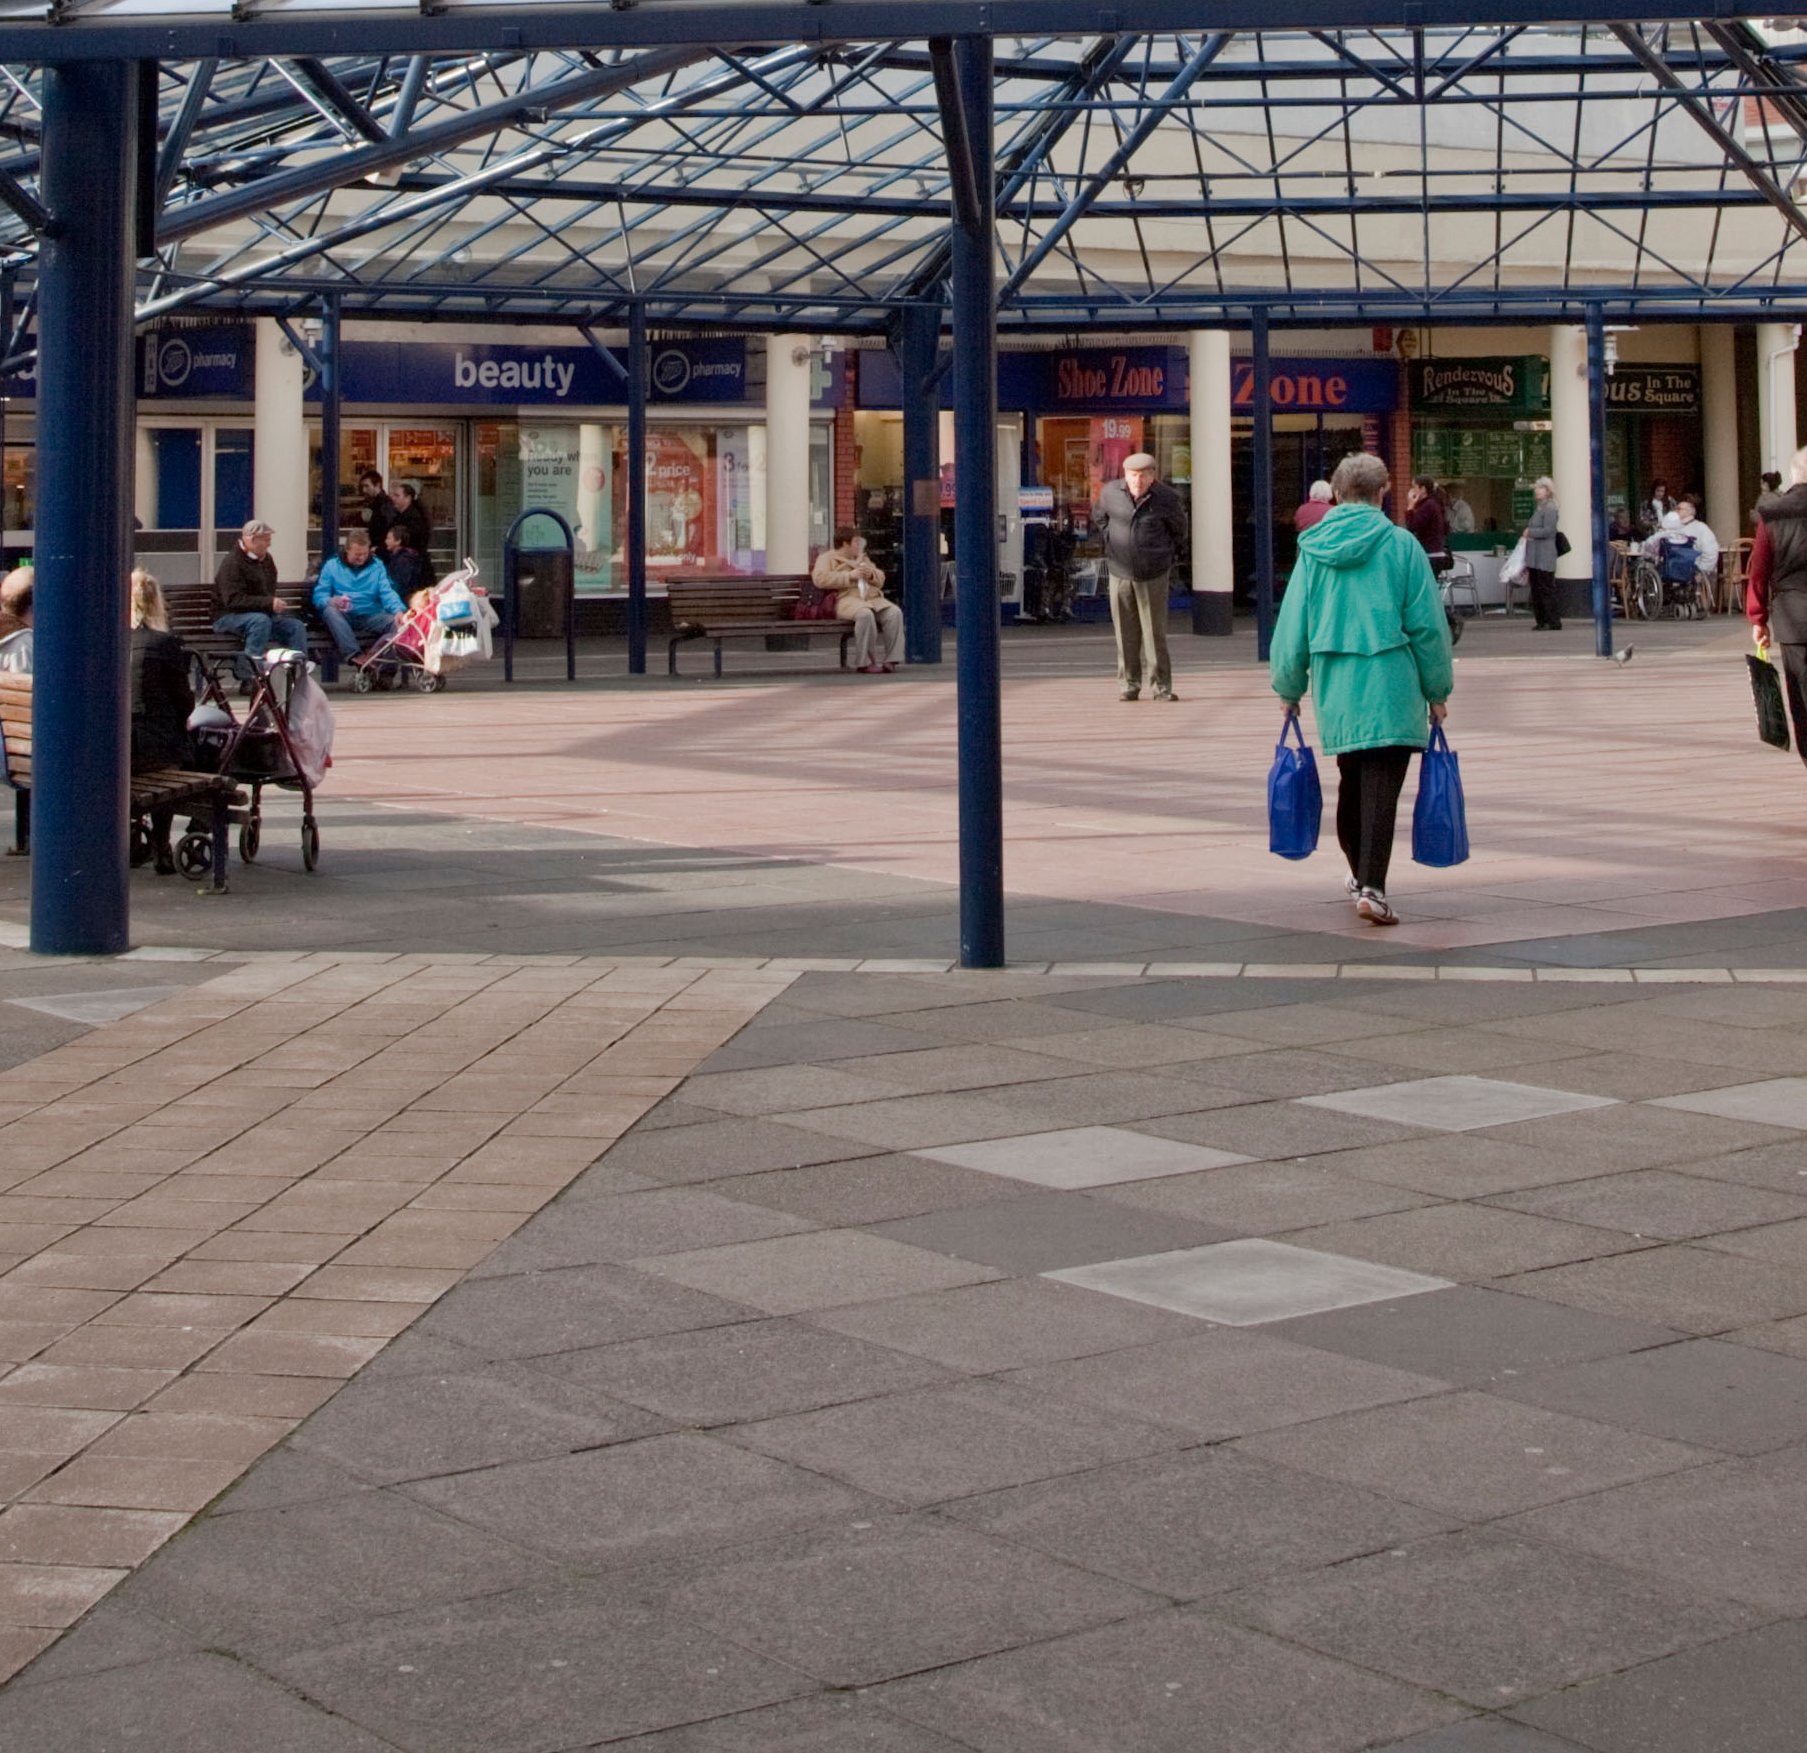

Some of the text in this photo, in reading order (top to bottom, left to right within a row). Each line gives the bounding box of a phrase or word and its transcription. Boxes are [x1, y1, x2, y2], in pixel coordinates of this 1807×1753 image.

[193, 351, 236, 370] pharmacy
[692, 360, 742, 379] pharmacy
[454, 351, 576, 397] beauty
[1058, 355, 1164, 398] Shoe Zone
[1646, 375, 1692, 389] In The
[1234, 363, 1347, 405] Zone
[1644, 389, 1694, 405] Square
[1102, 418, 1132, 439] 19.99
[527, 465, 572, 478] you are
[658, 462, 691, 478] price
[723, 451, 735, 473] 3
